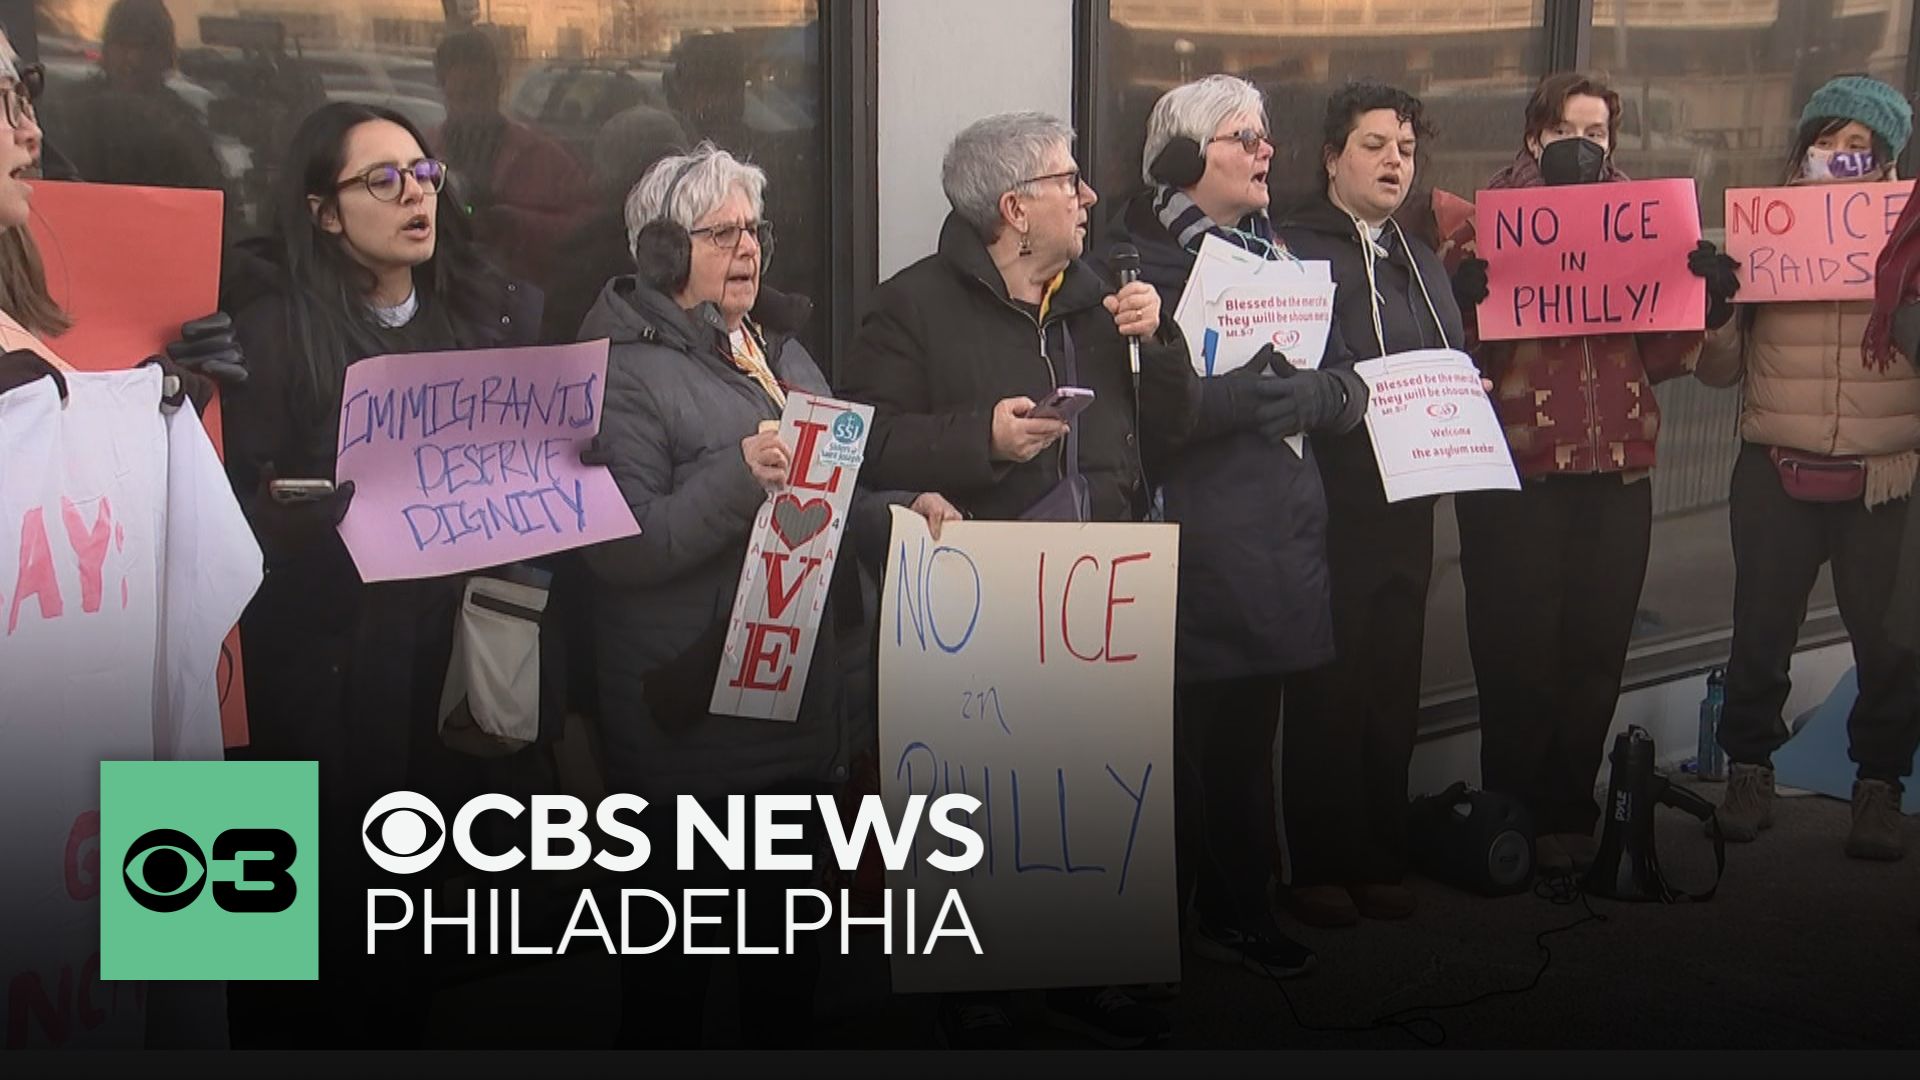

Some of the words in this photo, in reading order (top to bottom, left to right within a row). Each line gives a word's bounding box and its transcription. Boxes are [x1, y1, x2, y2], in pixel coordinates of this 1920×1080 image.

[1495, 206, 1559, 250] NO
[1603, 200, 1660, 243] ICE
[1732, 195, 1796, 236] NO
[1825, 191, 1911, 243] ICE
[1561, 250, 1587, 272] IN
[1749, 246, 1874, 295] RAIDS
[1218, 313, 1250, 327] They
[1252, 312, 1275, 323] will
[1276, 312, 1288, 323] be
[1225, 296, 1275, 311] Blessed
[1276, 296, 1287, 307] be
[1288, 296, 1300, 307] the
[1513, 281, 1661, 327] PHILLY!
[1371, 393, 1403, 408] They
[1404, 388, 1427, 401] will
[1427, 386, 1441, 397] be
[1376, 375, 1421, 393] Blessed
[1423, 373, 1438, 383] be
[339, 373, 598, 457] IMMIGRANTS
[1430, 427, 1471, 438] Welcome
[414, 438, 573, 498] DESERVE
[1411, 447, 1432, 459] the
[1433, 444, 1469, 459] asylum
[402, 480, 586, 551] DIGNITY
[896, 536, 981, 654] NO
[1038, 552, 1152, 664] ICE
[961, 675, 1011, 735] in
